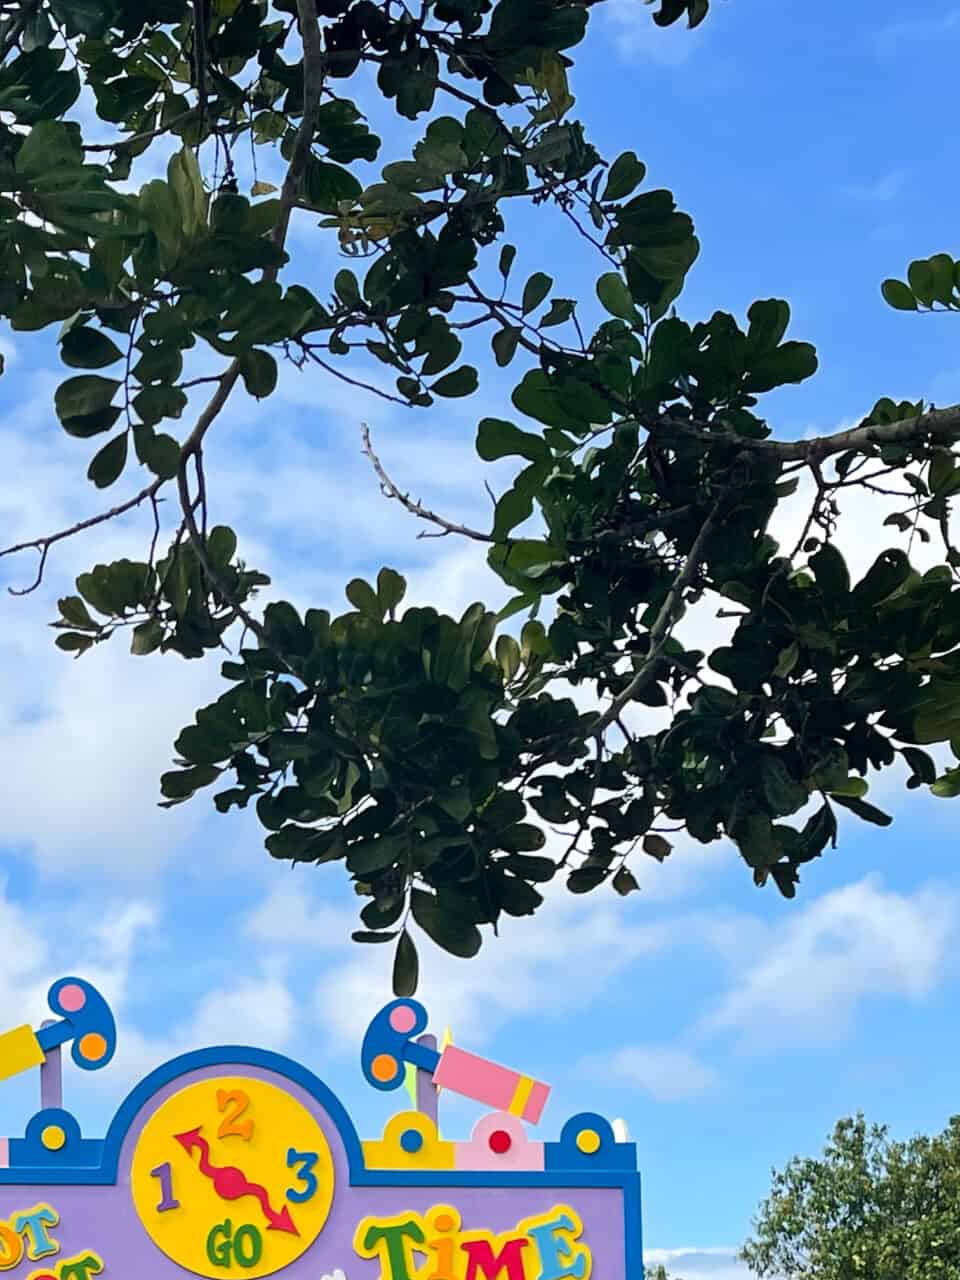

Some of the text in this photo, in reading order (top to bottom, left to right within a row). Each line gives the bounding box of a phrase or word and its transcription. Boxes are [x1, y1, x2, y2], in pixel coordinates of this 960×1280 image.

[215, 1088, 255, 1142] 2
[150, 1161, 181, 1213] 1
[285, 1148, 320, 1204] 3
[206, 1218, 263, 1269] GO
